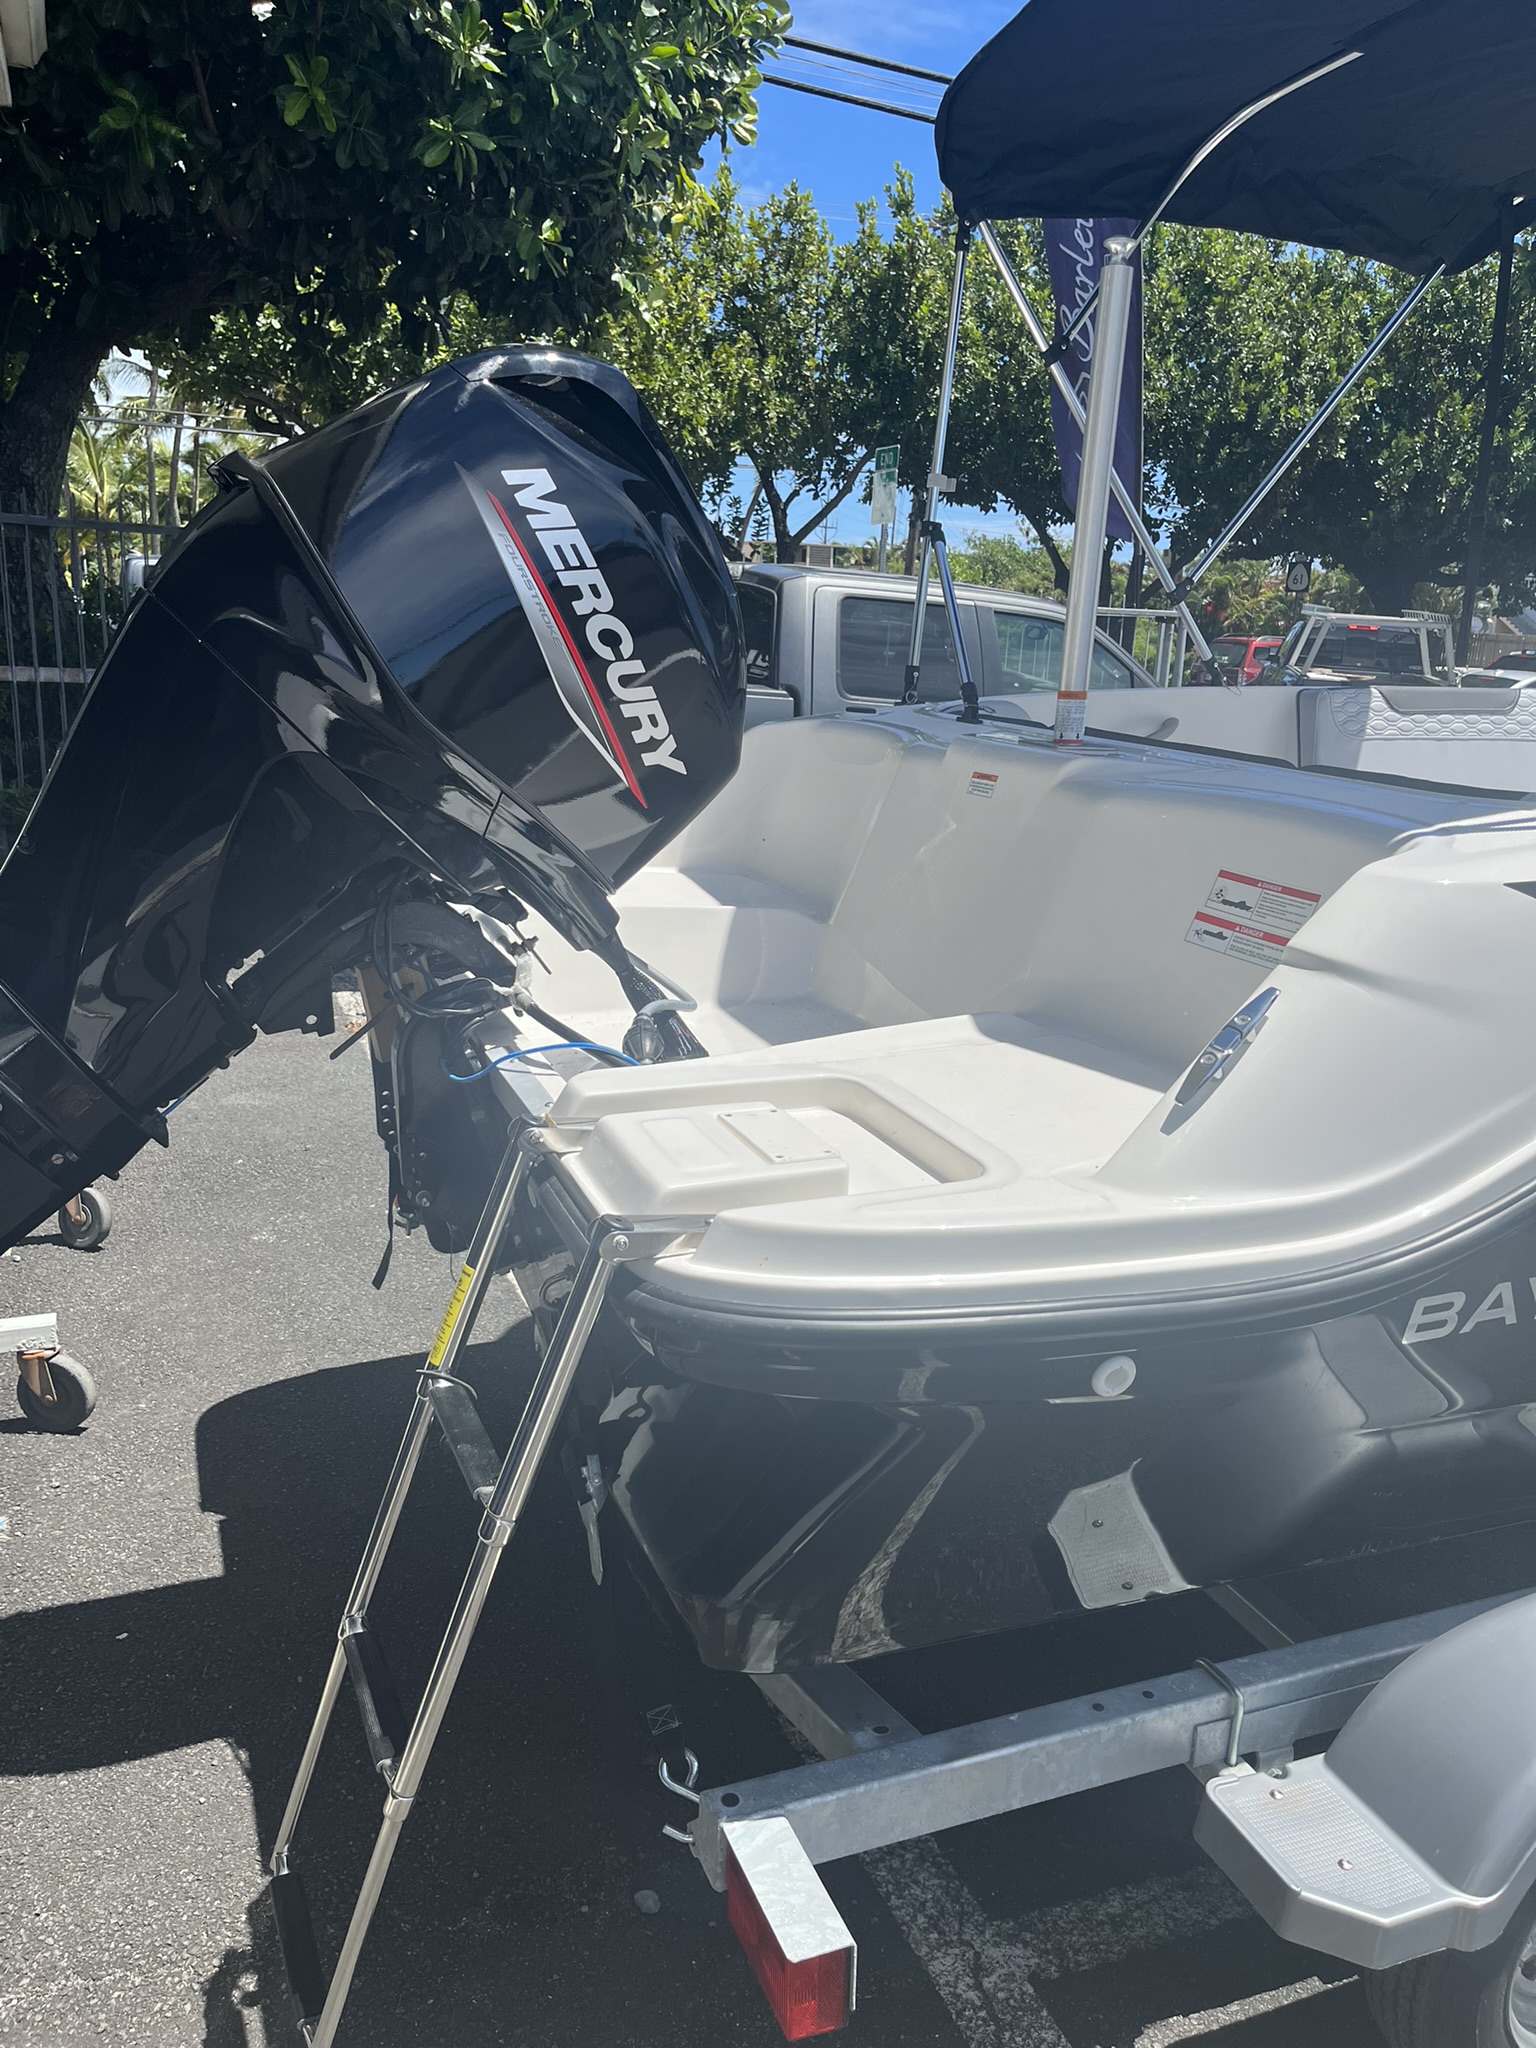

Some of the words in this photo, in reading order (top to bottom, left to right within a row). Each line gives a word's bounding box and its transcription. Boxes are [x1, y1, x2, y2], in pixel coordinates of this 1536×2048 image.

[880, 451, 894, 466] END
[1292, 573, 1304, 585] 61
[501, 468, 688, 775] MERCURY
[1261, 882, 1282, 893] DANGER
[1240, 926, 1264, 939] DANGER
[1401, 1277, 1536, 1344] BA
